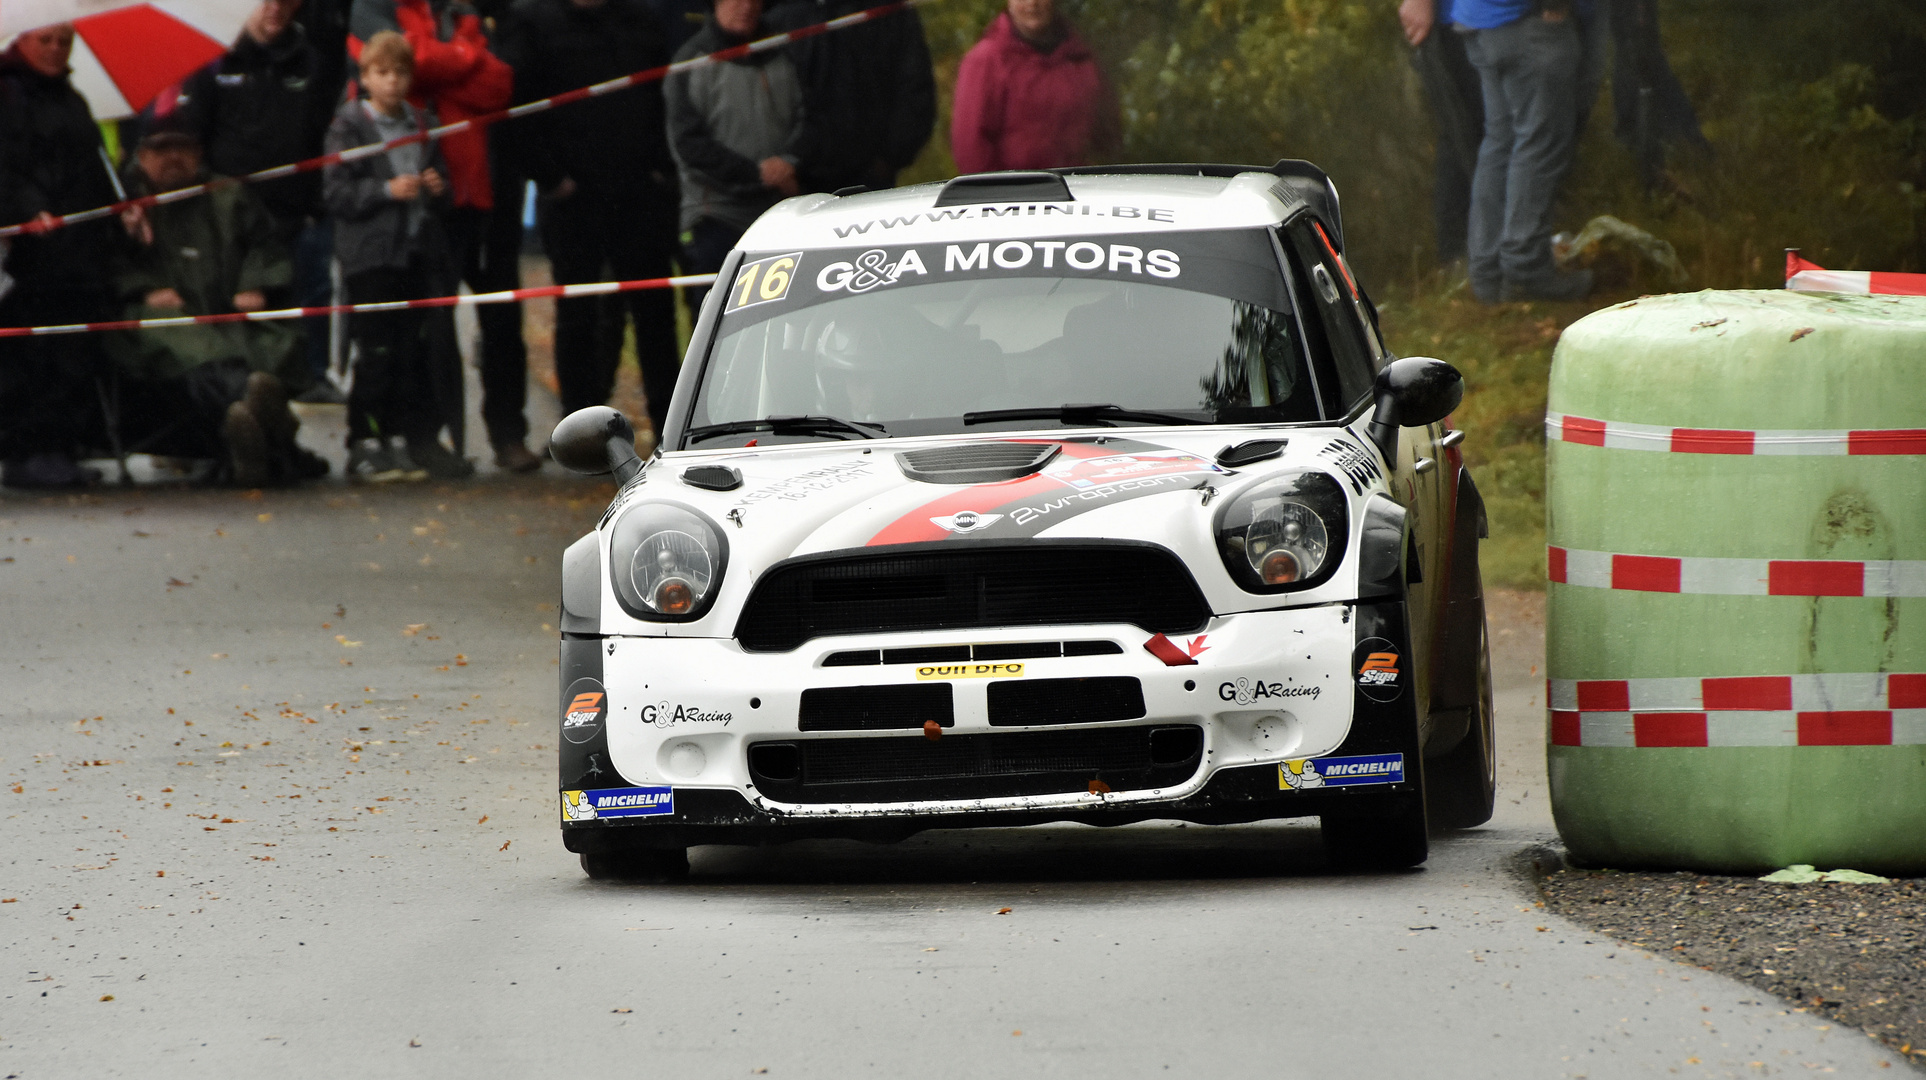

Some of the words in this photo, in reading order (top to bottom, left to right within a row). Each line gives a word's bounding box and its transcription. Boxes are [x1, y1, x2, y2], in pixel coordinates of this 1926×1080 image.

[833, 204, 1175, 239] WWW.MINI.BE
[816, 248, 928, 293] G&A
[944, 241, 1182, 279] MOTORS
[737, 257, 794, 307] 16
[777, 468, 874, 502] 16-12-2017
[1009, 474, 1191, 526] 2wrap.com
[955, 516, 977, 524] MINI
[1360, 652, 1399, 675] 2
[1359, 669, 1398, 685] Sign
[565, 692, 604, 718] 2
[564, 711, 598, 726] Sign
[1325, 761, 1402, 775] MICHELIN
[597, 793, 672, 807] MICHELIN
